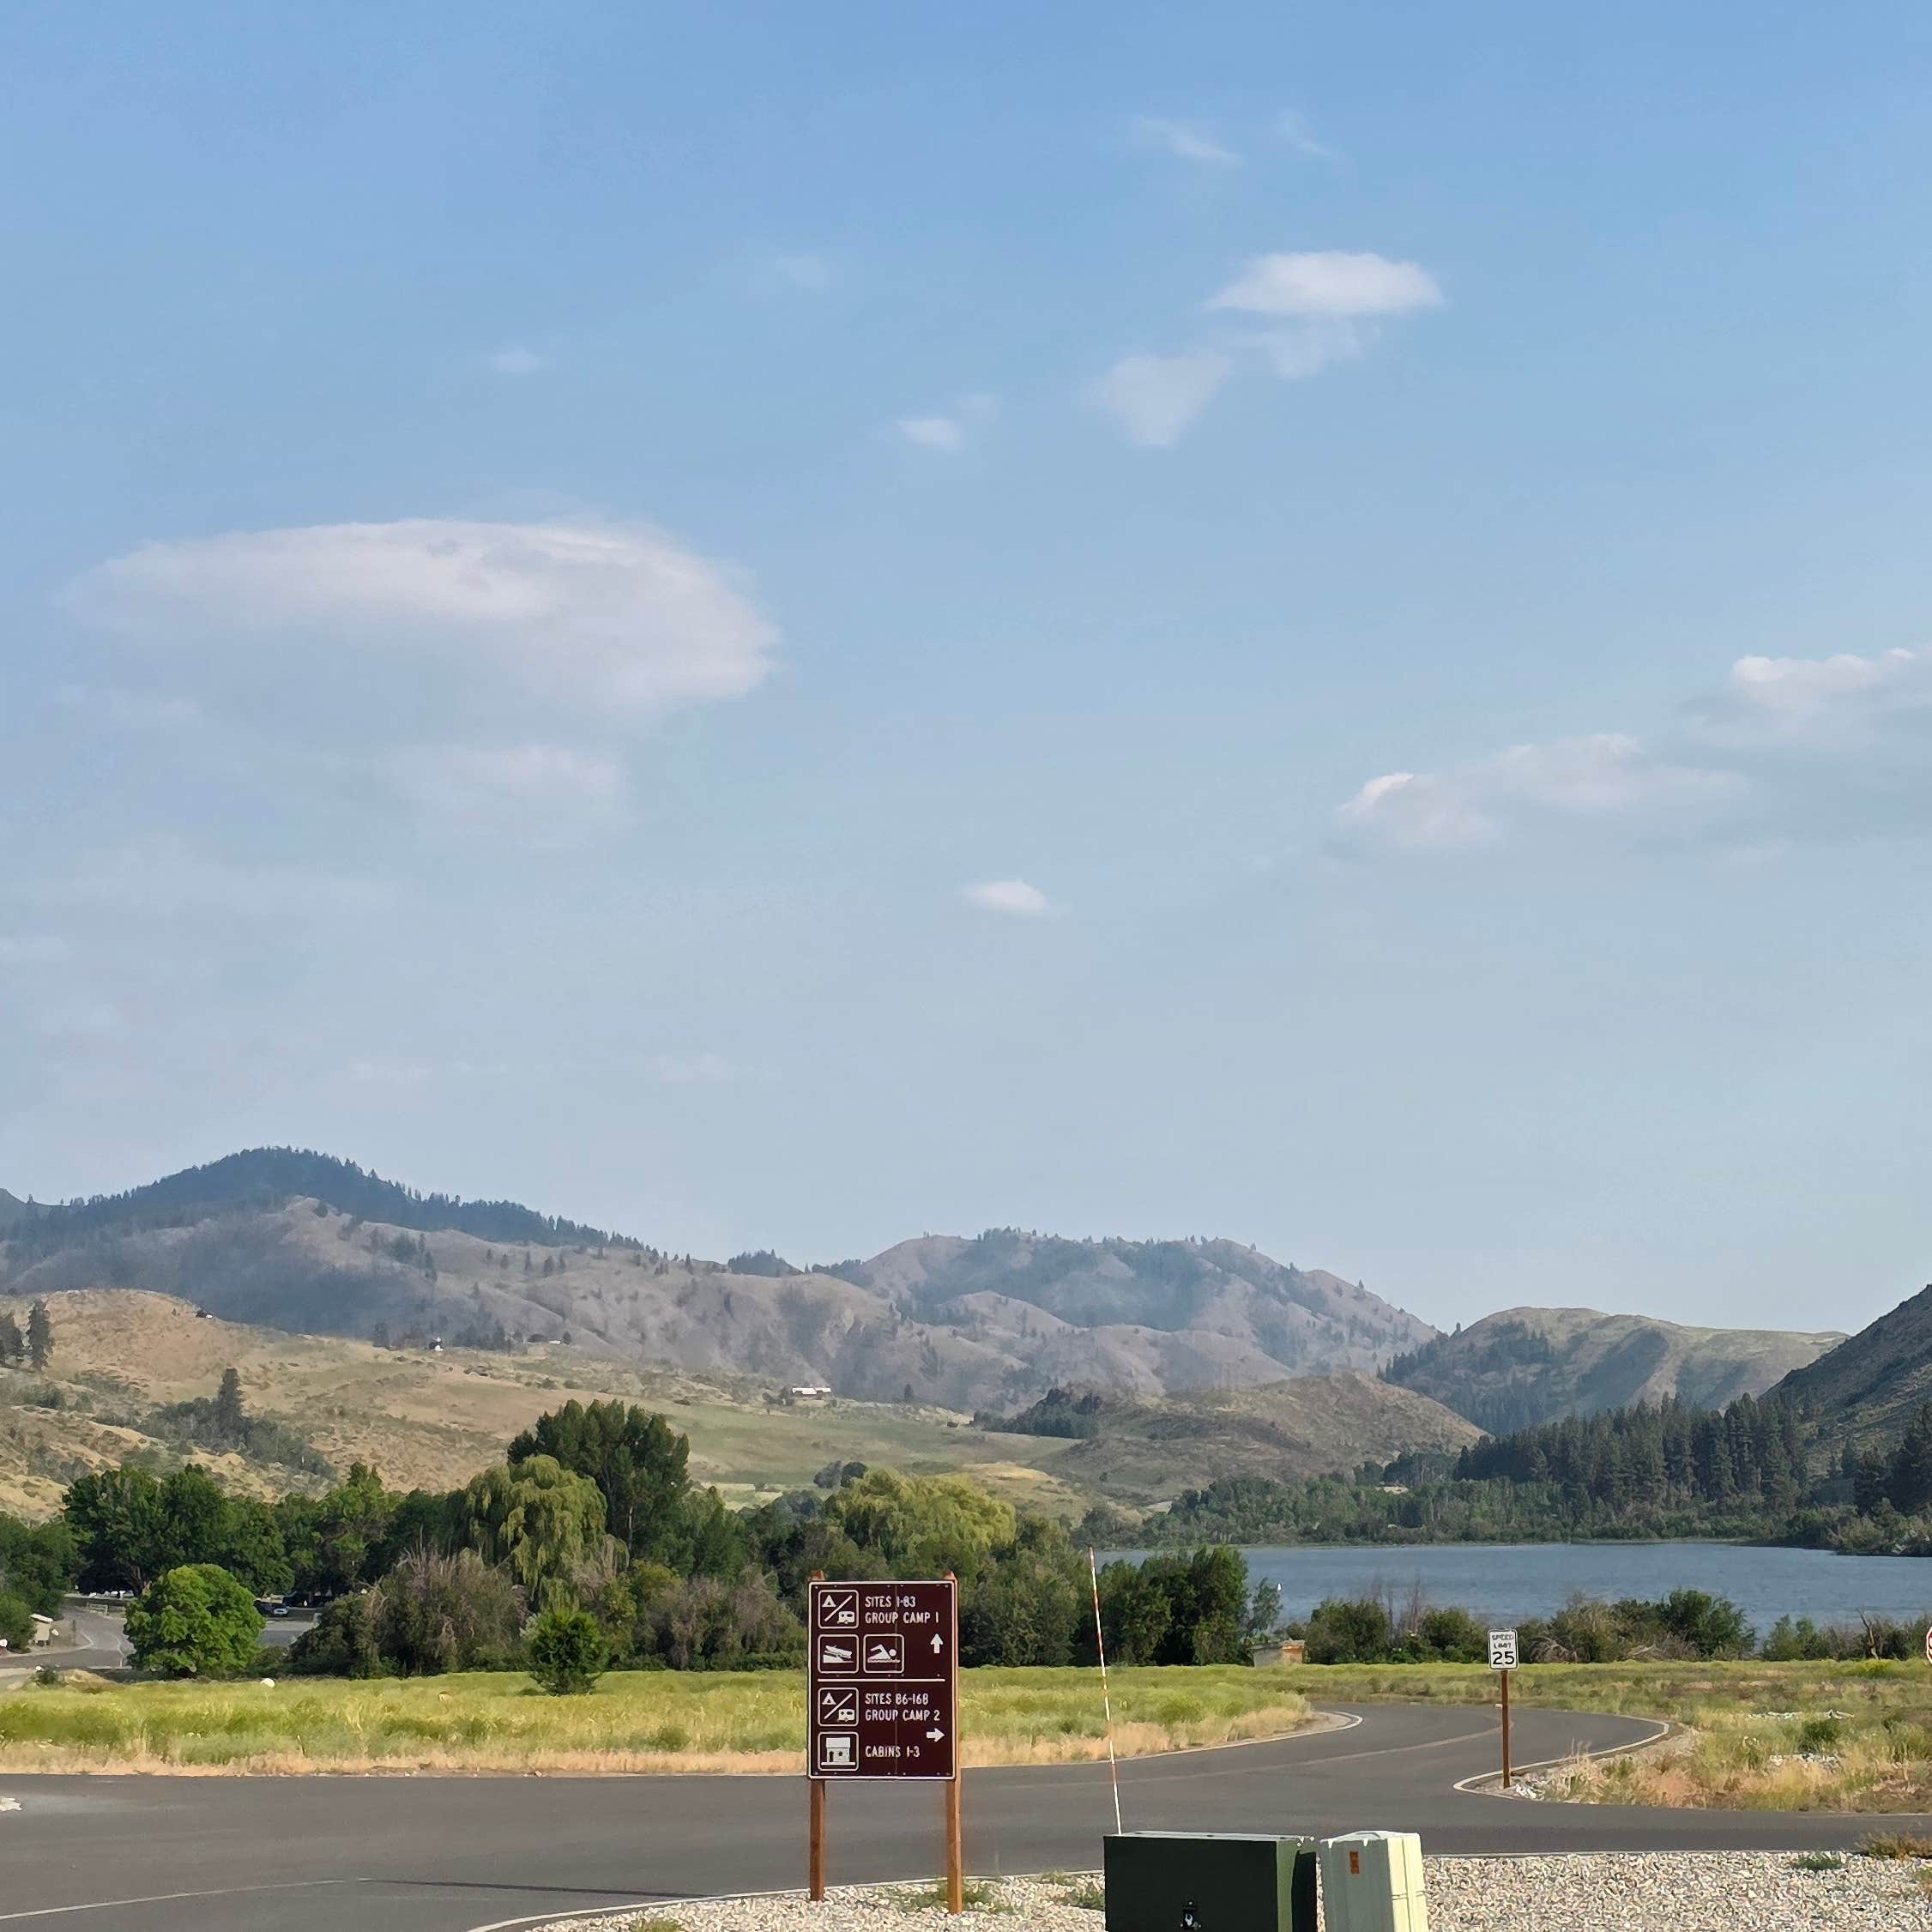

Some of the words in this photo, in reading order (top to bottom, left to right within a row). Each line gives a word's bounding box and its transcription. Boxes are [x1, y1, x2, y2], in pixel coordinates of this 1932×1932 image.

[865, 1596, 891, 1608] SITES
[865, 1612, 898, 1624] GROUP
[903, 1612, 931, 1624] CAMP
[935, 1611, 939, 1623] 1
[1493, 1651, 1515, 1664] 25
[865, 1693, 891, 1705] SITES
[865, 1709, 898, 1721] GROUP
[903, 1709, 931, 1721] CAMP
[933, 1709, 940, 1721] 2
[865, 1745, 901, 1758] CABINS
[906, 1745, 921, 1758] 1-3
